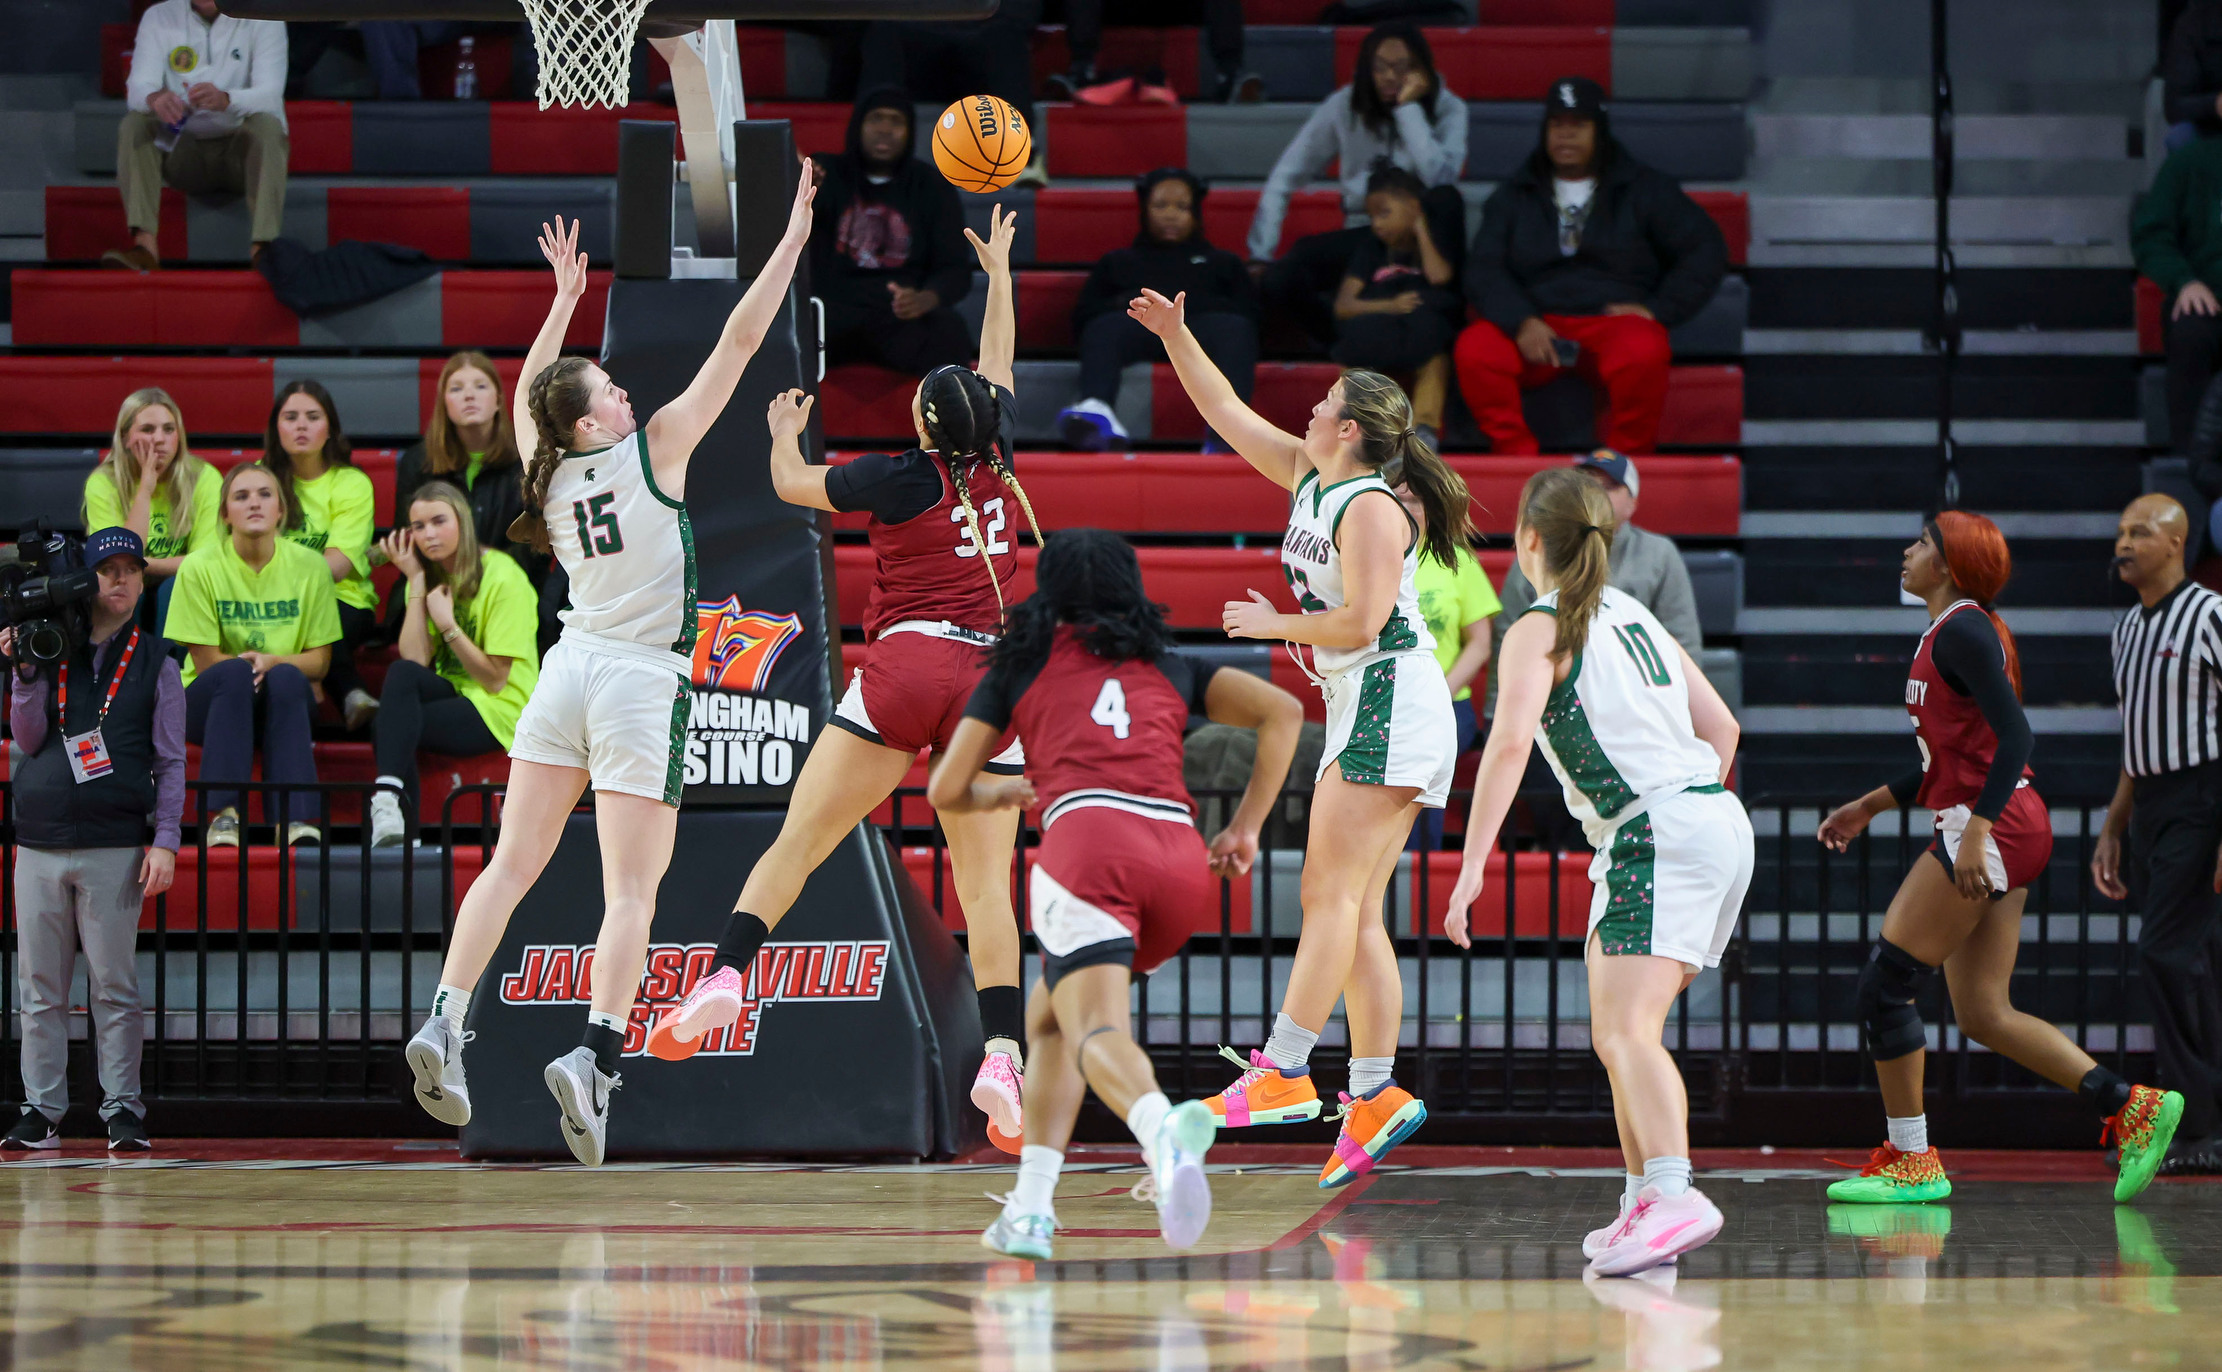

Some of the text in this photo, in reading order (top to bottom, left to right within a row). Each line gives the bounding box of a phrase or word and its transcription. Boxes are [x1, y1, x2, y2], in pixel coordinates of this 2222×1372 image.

[975, 94, 998, 139] Wilso
[99, 541, 136, 552] MATHEW
[572, 489, 625, 560] 15
[950, 497, 1009, 558] 32
[1609, 622, 1672, 688] 10
[687, 691, 810, 744] NGHAM
[1089, 677, 1132, 740] 4
[699, 730, 766, 742] COURSE
[684, 740, 793, 786] SINO
